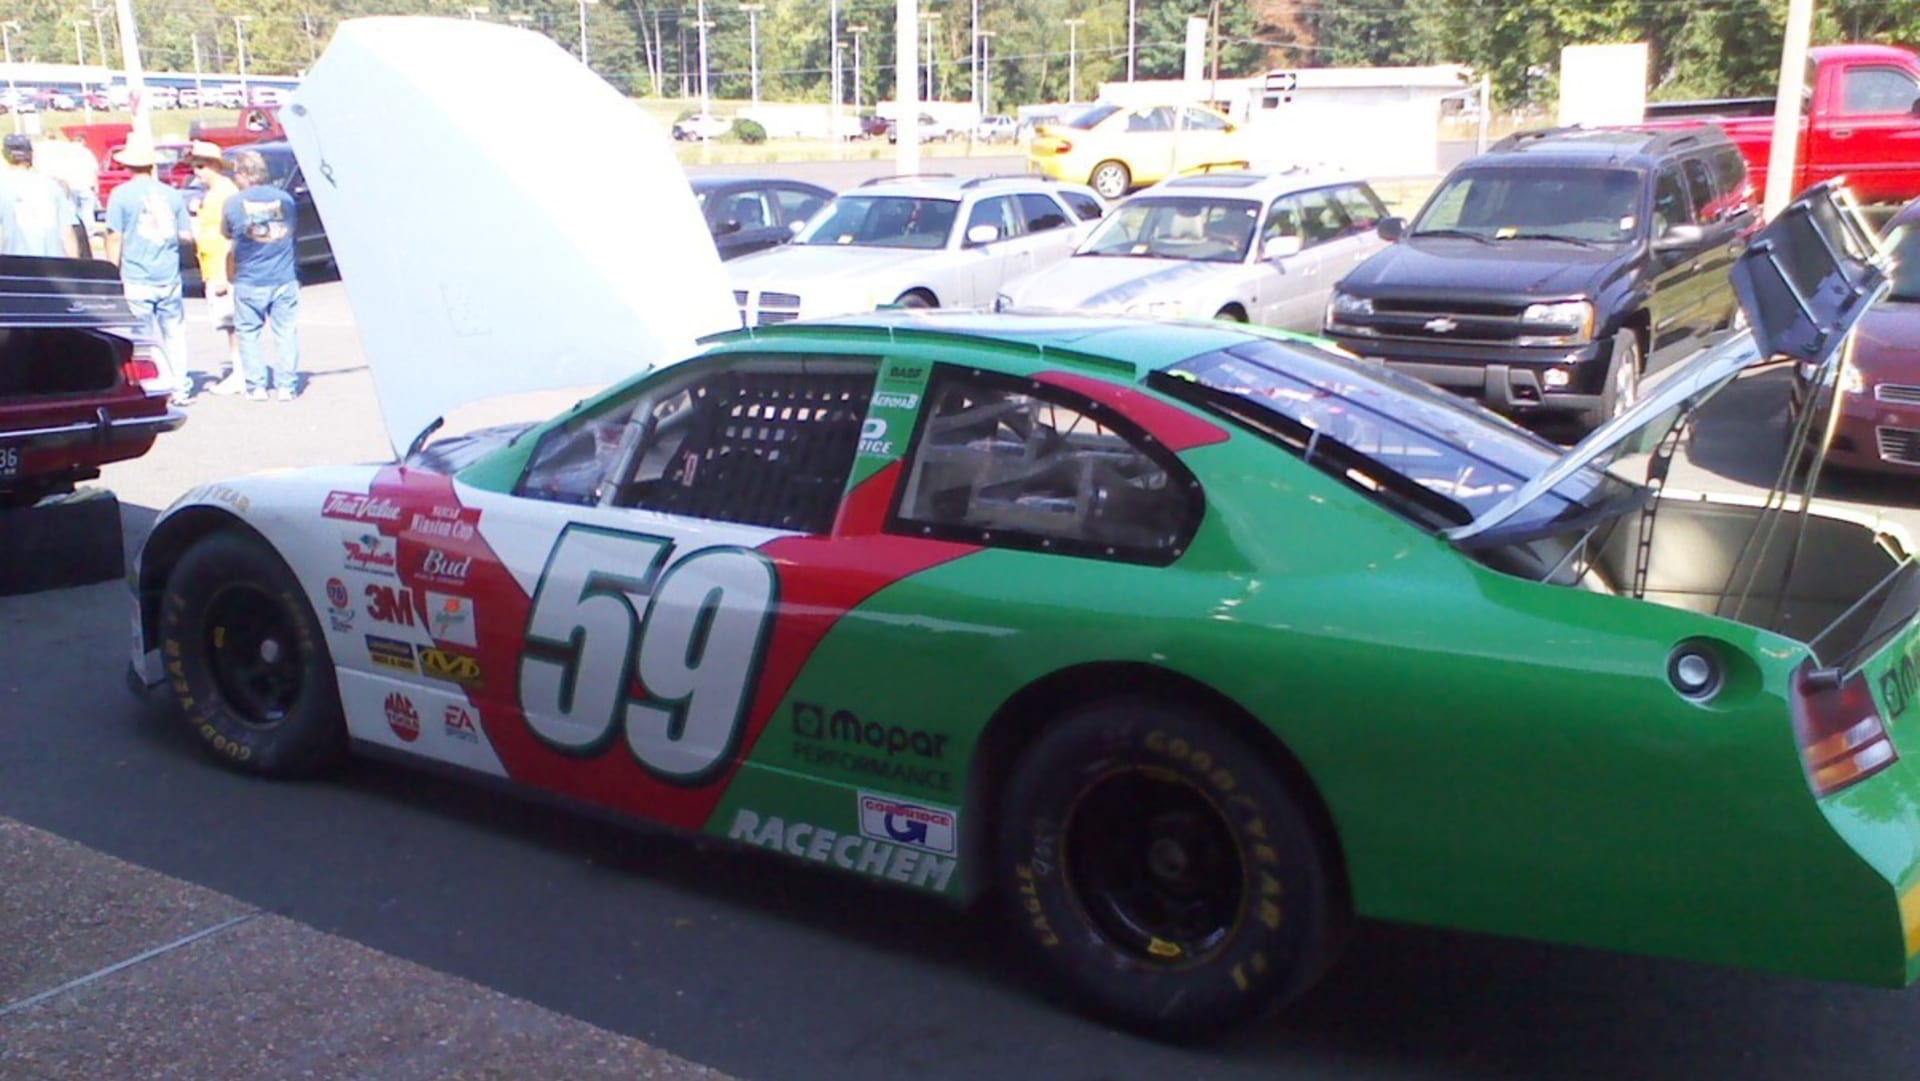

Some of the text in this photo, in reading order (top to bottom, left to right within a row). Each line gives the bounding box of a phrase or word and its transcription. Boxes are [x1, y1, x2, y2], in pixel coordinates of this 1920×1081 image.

[423, 549, 472, 578] Bud
[365, 583, 415, 627] 3M
[519, 521, 781, 787] 59
[444, 704, 477, 733] EA
[792, 741, 954, 792] PERFORMANCE
[728, 808, 958, 892] RACECHEM
